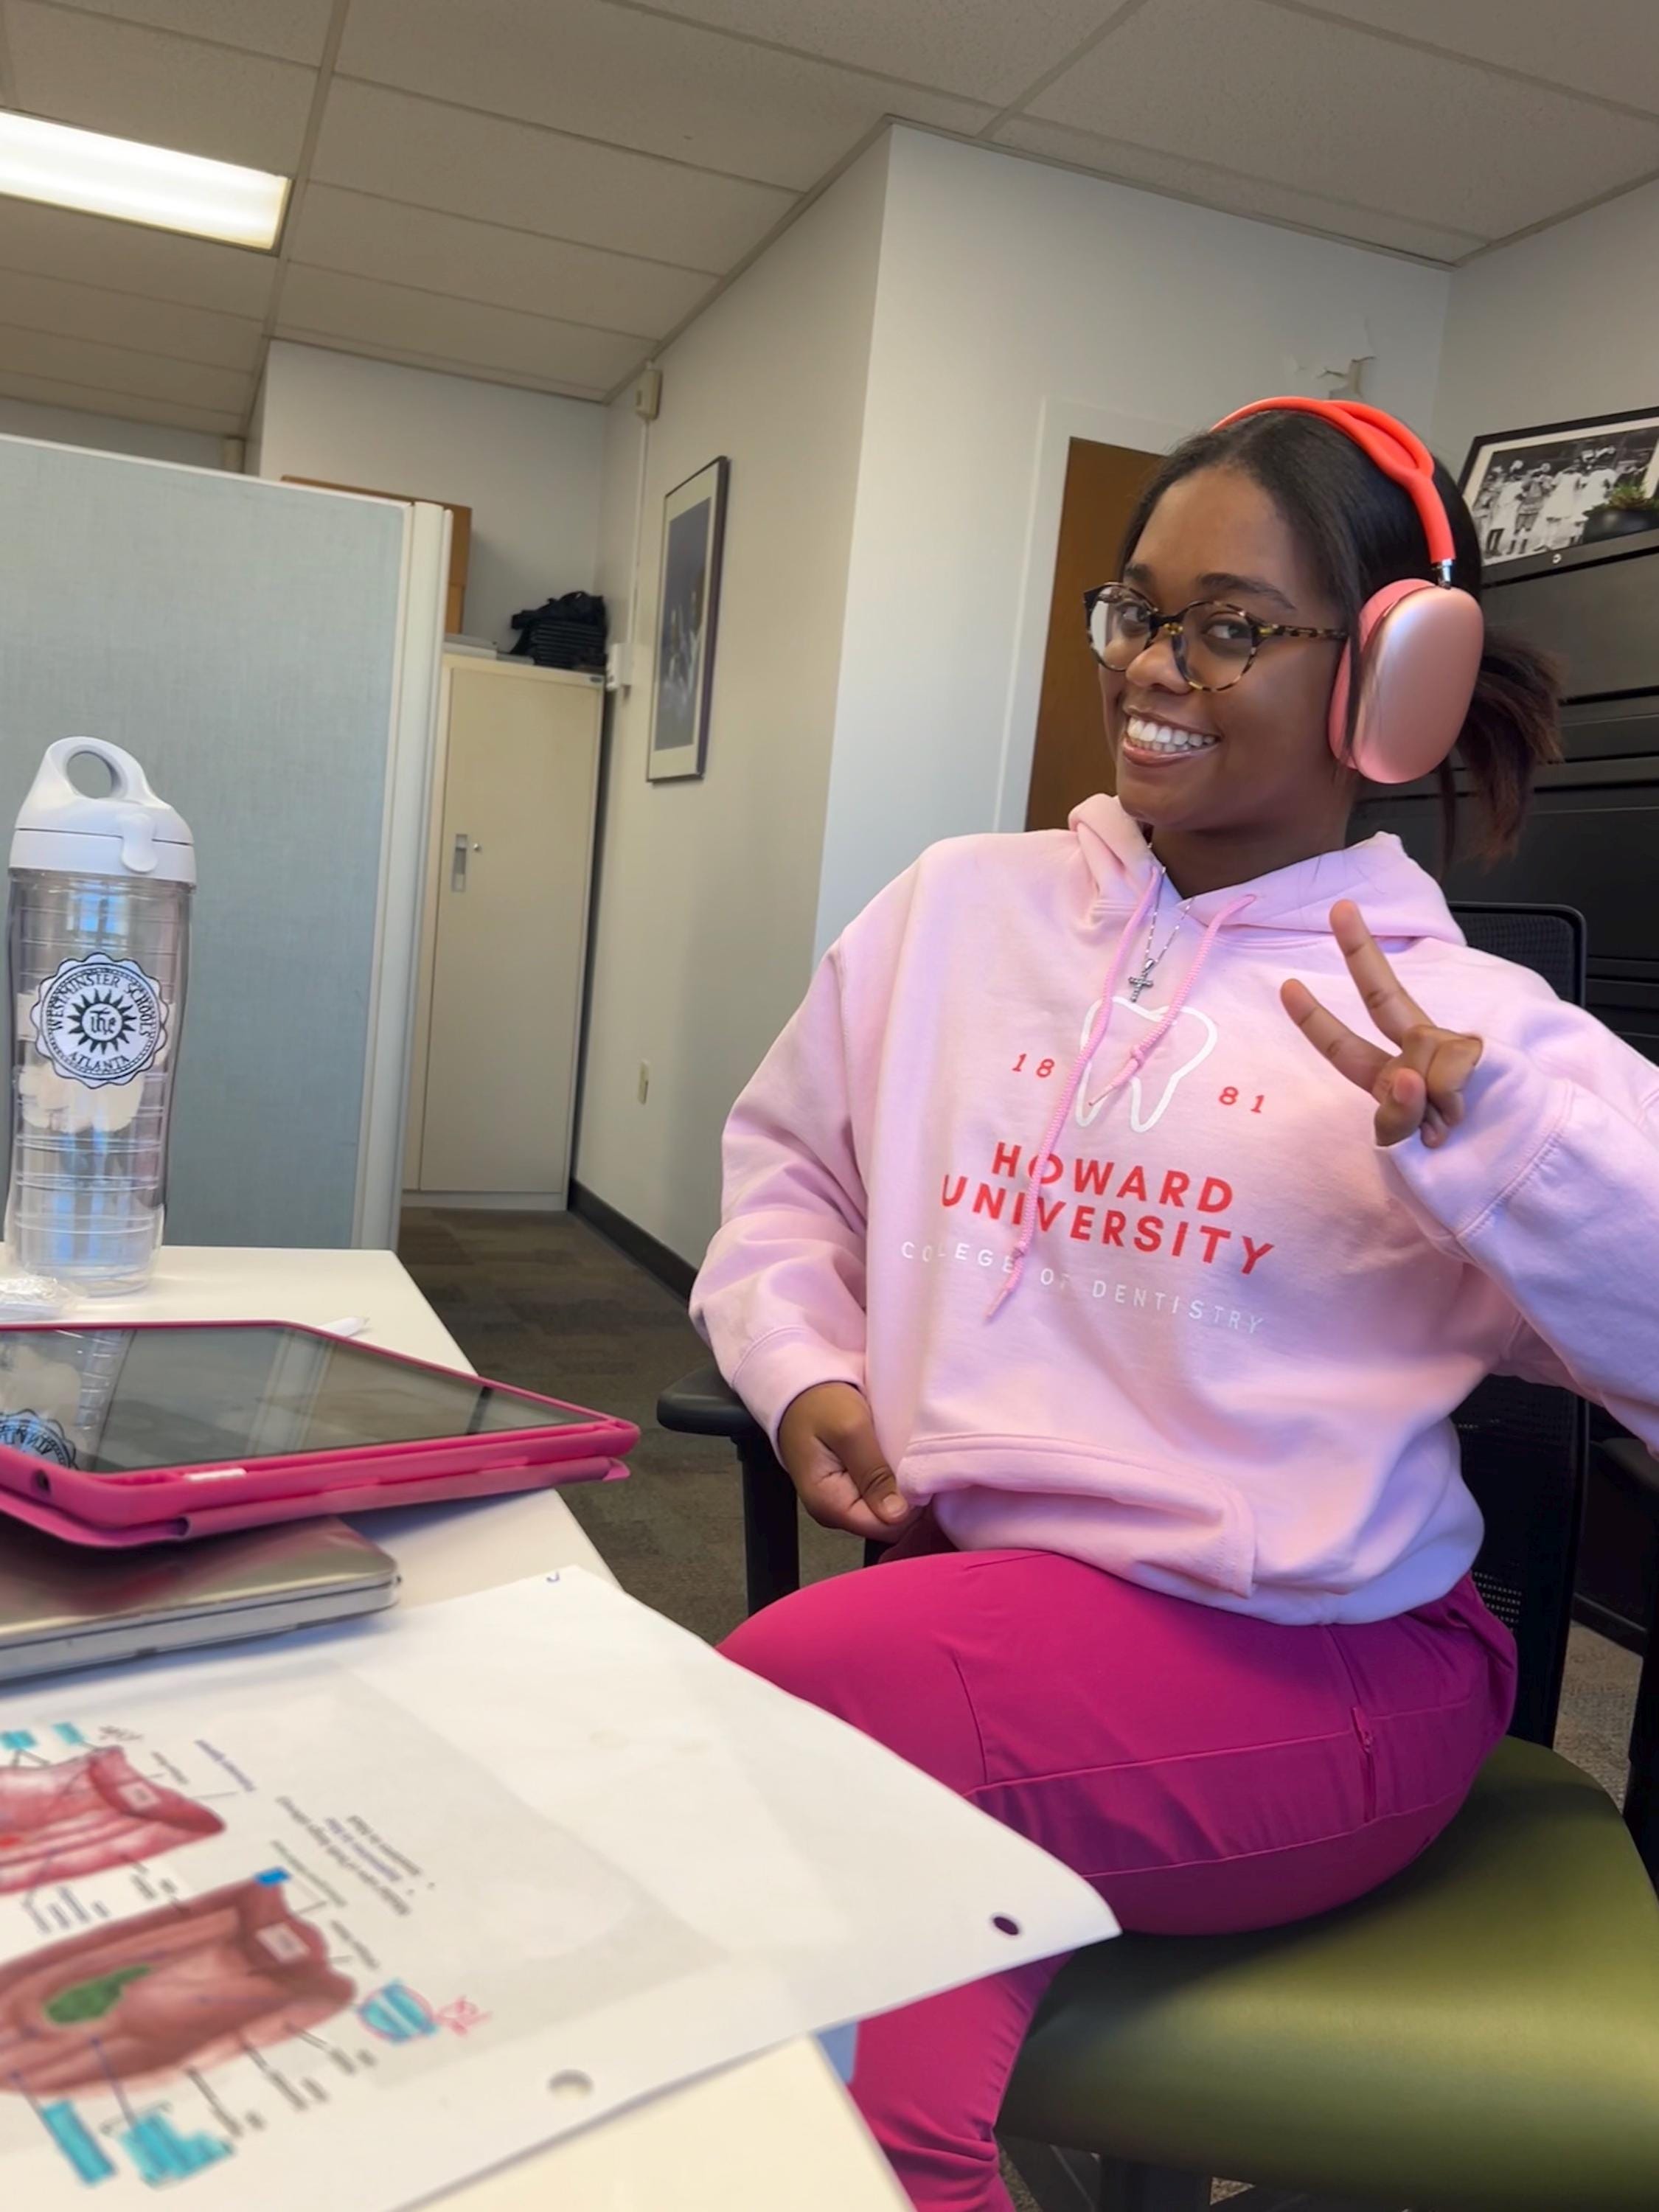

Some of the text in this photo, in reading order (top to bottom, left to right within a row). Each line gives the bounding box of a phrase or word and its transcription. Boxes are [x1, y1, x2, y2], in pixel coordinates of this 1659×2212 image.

[49, 973, 154, 1037] WESTMINSTER SCHOOLS
[70, 1051, 130, 1071] ATLANTA
[1012, 1053, 1265, 1114] 18 81
[991, 1141, 1233, 1214] HOWARD
[942, 1174, 1275, 1275] UNIVERSITY
[1092, 1280, 1264, 1333] DENTISTRY
